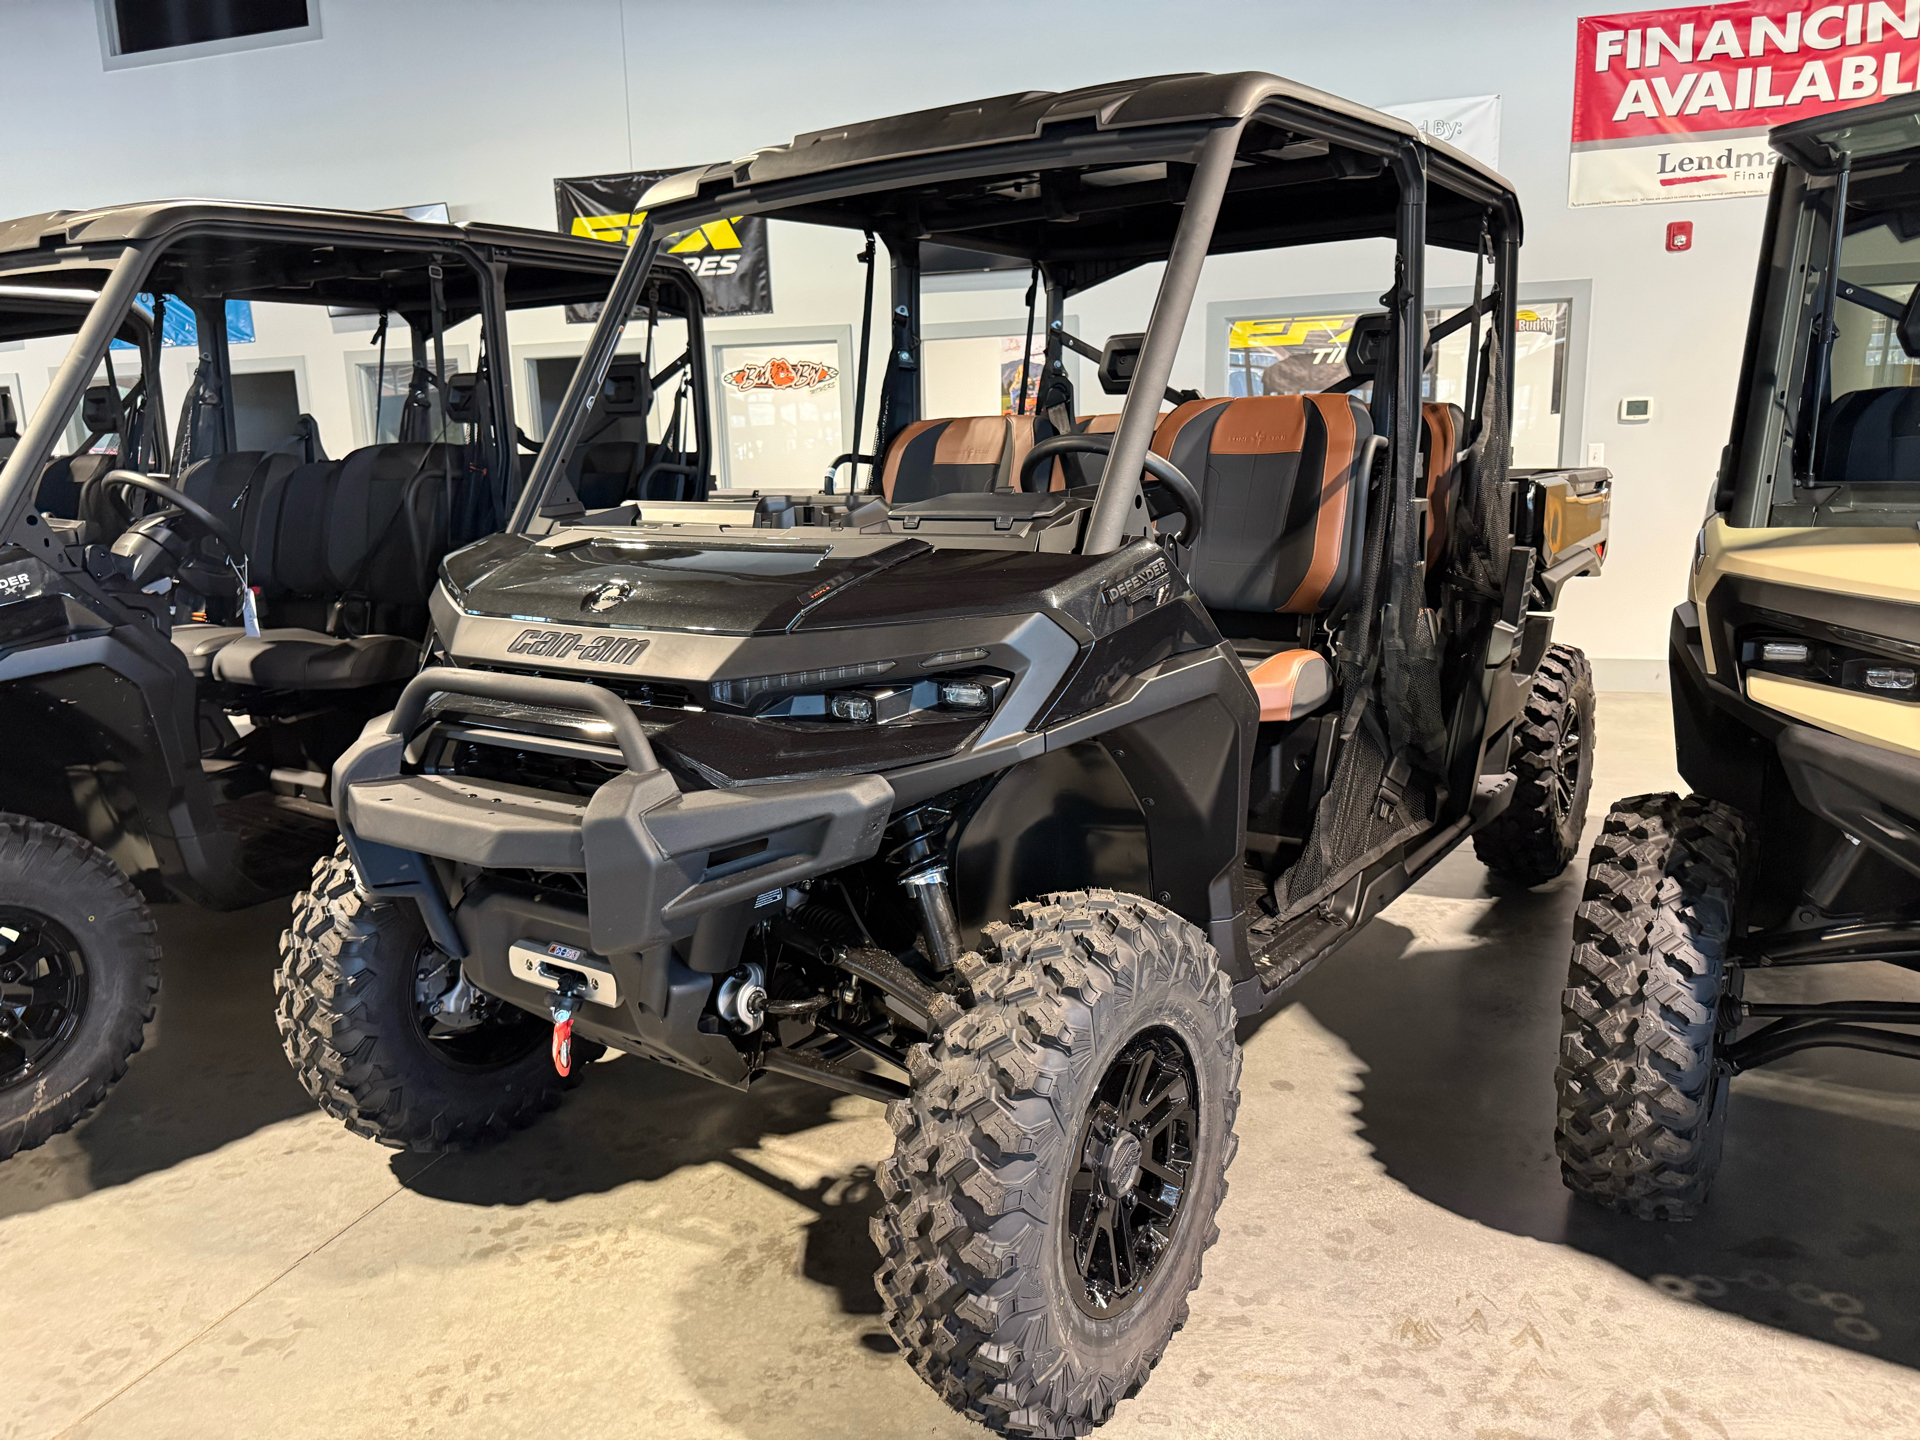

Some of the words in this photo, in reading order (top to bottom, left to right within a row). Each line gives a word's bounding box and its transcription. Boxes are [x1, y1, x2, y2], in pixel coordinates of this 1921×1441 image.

[1612, 51, 1920, 121] AVAILABL
[1434, 119, 1463, 140] By:
[683, 254, 742, 278] RES
[4, 582, 31, 596] XT
[1109, 561, 1168, 601] DEFENDER
